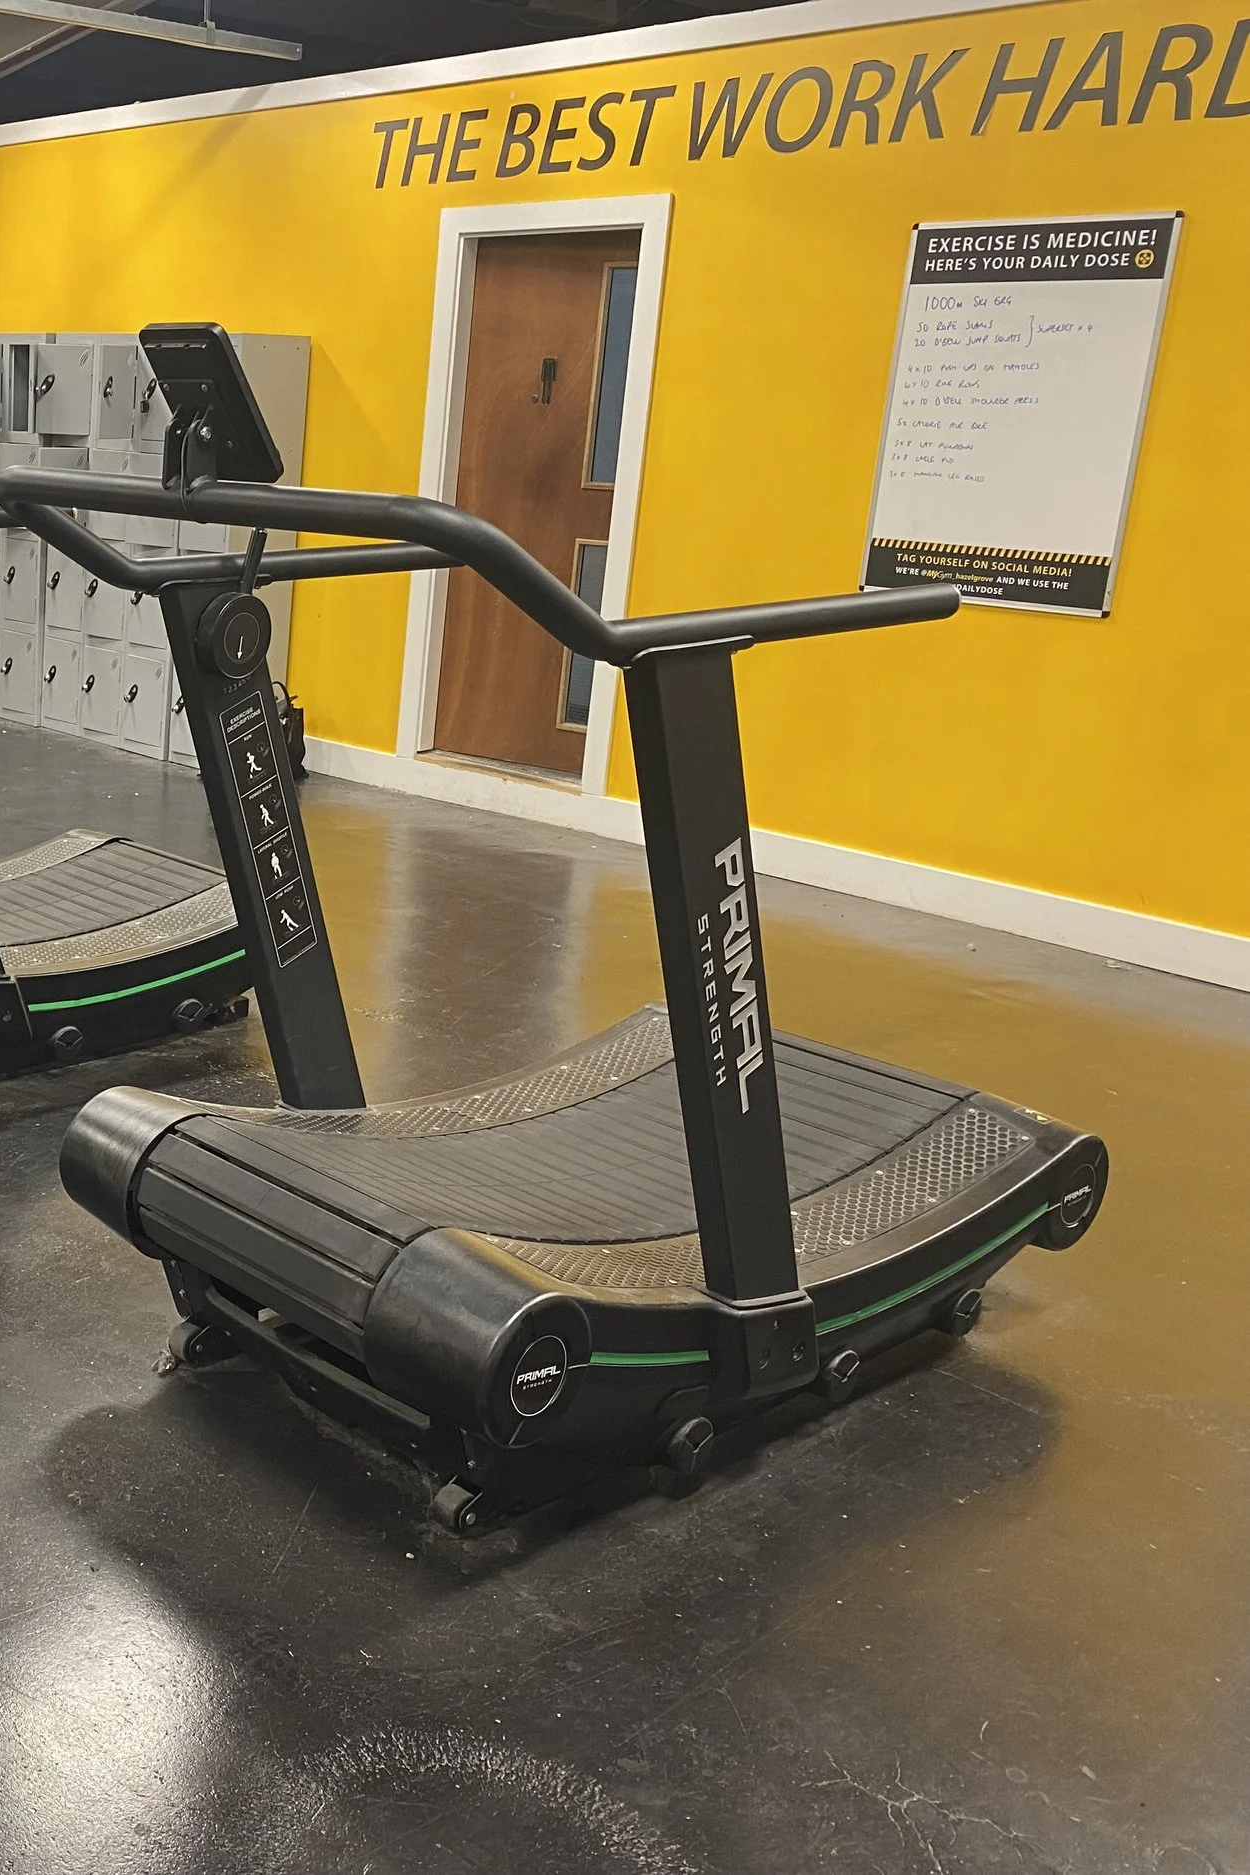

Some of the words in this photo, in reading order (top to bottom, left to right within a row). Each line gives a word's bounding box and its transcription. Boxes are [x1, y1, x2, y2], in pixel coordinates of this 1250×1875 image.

[373, 109, 489, 188] THE
[494, 85, 676, 178] BEST
[687, 48, 972, 161] WORK
[927, 234, 1017, 253] EXERCISE
[1022, 233, 1041, 249] IS
[1047, 229, 1158, 249] MEDICINE!
[924, 257, 977, 272] HERE'S
[982, 256, 1025, 270] YOUR
[1030, 254, 1080, 269] DAILY
[1084, 252, 1131, 267] DOSE
[914, 338, 926, 348] 20
[897, 553, 916, 563] TAG
[919, 555, 970, 568] YOURSELF
[973, 560, 989, 570] ON
[991, 562, 1030, 574] SOCIAL
[1032, 566, 1073, 577] MEDIA!
[895, 566, 919, 576] WE'RE
[996, 575, 1016, 585] AND
[1017, 578, 1031, 587] WE
[1032, 580, 1049, 589] USE
[1051, 581, 1069, 590] THE
[226, 708, 261, 734] DESCRIPTIONS
[230, 706, 254, 725] EXERCISE
[714, 837, 764, 1114] PRIMAL
[697, 913, 726, 1086] STRENGTH
[1063, 1185, 1092, 1203] PRIMAL
[516, 1365, 561, 1385] PRIMAL
